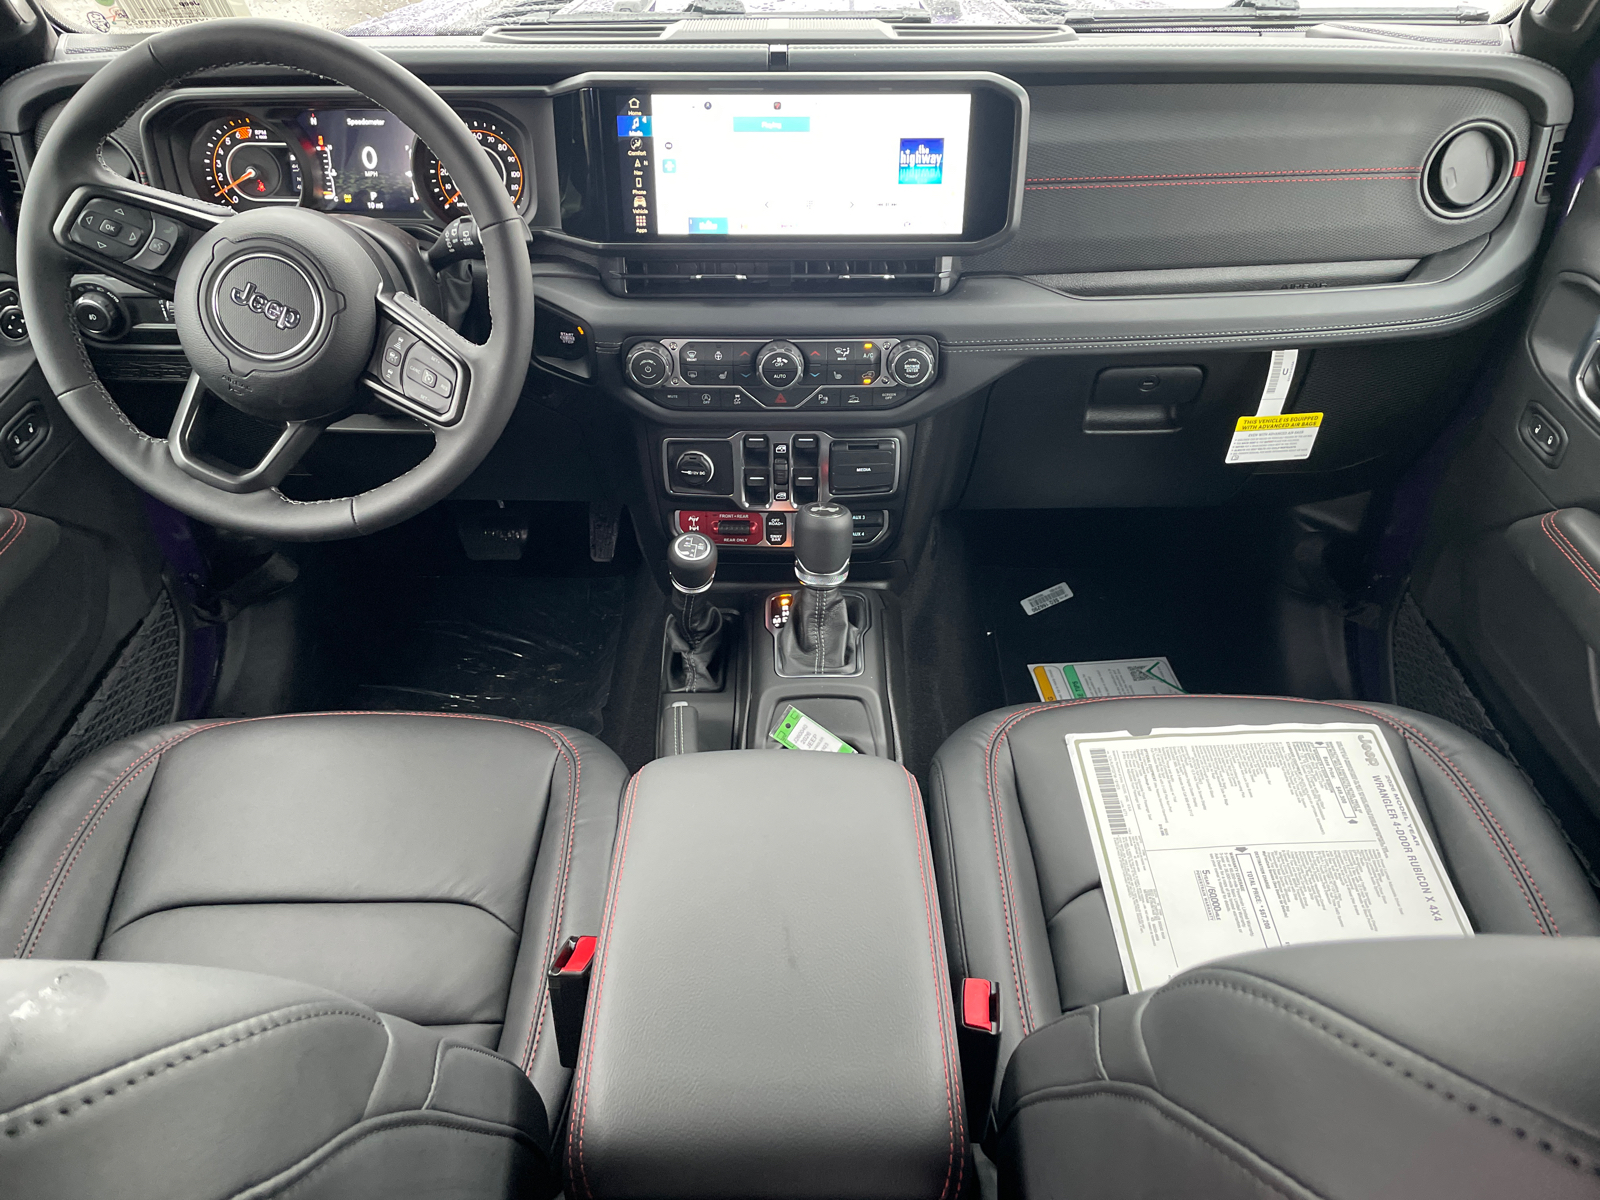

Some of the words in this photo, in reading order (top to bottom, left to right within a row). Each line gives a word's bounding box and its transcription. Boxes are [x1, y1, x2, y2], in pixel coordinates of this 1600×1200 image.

[310, 118, 317, 126] N
[346, 118, 385, 126] Speedometer
[235, 131, 241, 139] 6
[225, 137, 231, 145] 5
[498, 143, 508, 151] 80
[218, 148, 224, 156] 4
[362, 146, 378, 170] 0
[900, 148, 942, 167] highway
[216, 160, 222, 168] 3
[218, 173, 224, 181] 2
[232, 196, 239, 204] 0
[370, 192, 377, 200] P
[105, 224, 116, 232] OK
[106, 291, 120, 303] AUTO
[230, 281, 301, 331] Jeep
[1290, 415, 1319, 423] EQUIPPED
[807, 734, 817, 749] JEEP
[1357, 734, 1379, 766] Jeep
[1384, 775, 1396, 792] 2026
[1393, 793, 1408, 821] MODEL
[1407, 823, 1420, 846] YEAR
[1372, 775, 1398, 819] WRANGLER
[1393, 821, 1413, 853] 4-DOOR
[1407, 855, 1432, 893] RUBICON
[1429, 904, 1443, 921] 4X4
[1229, 852, 1238, 871] WARRANTY
[1235, 872, 1245, 891] COVERAGE
[1196, 870, 1206, 896] POWERTRAIN
[1205, 897, 1213, 920] WARRANTY
[1246, 871, 1256, 886] TOTAL
[1252, 887, 1262, 904] PRICE:
[1259, 909, 1271, 929] $67,200
